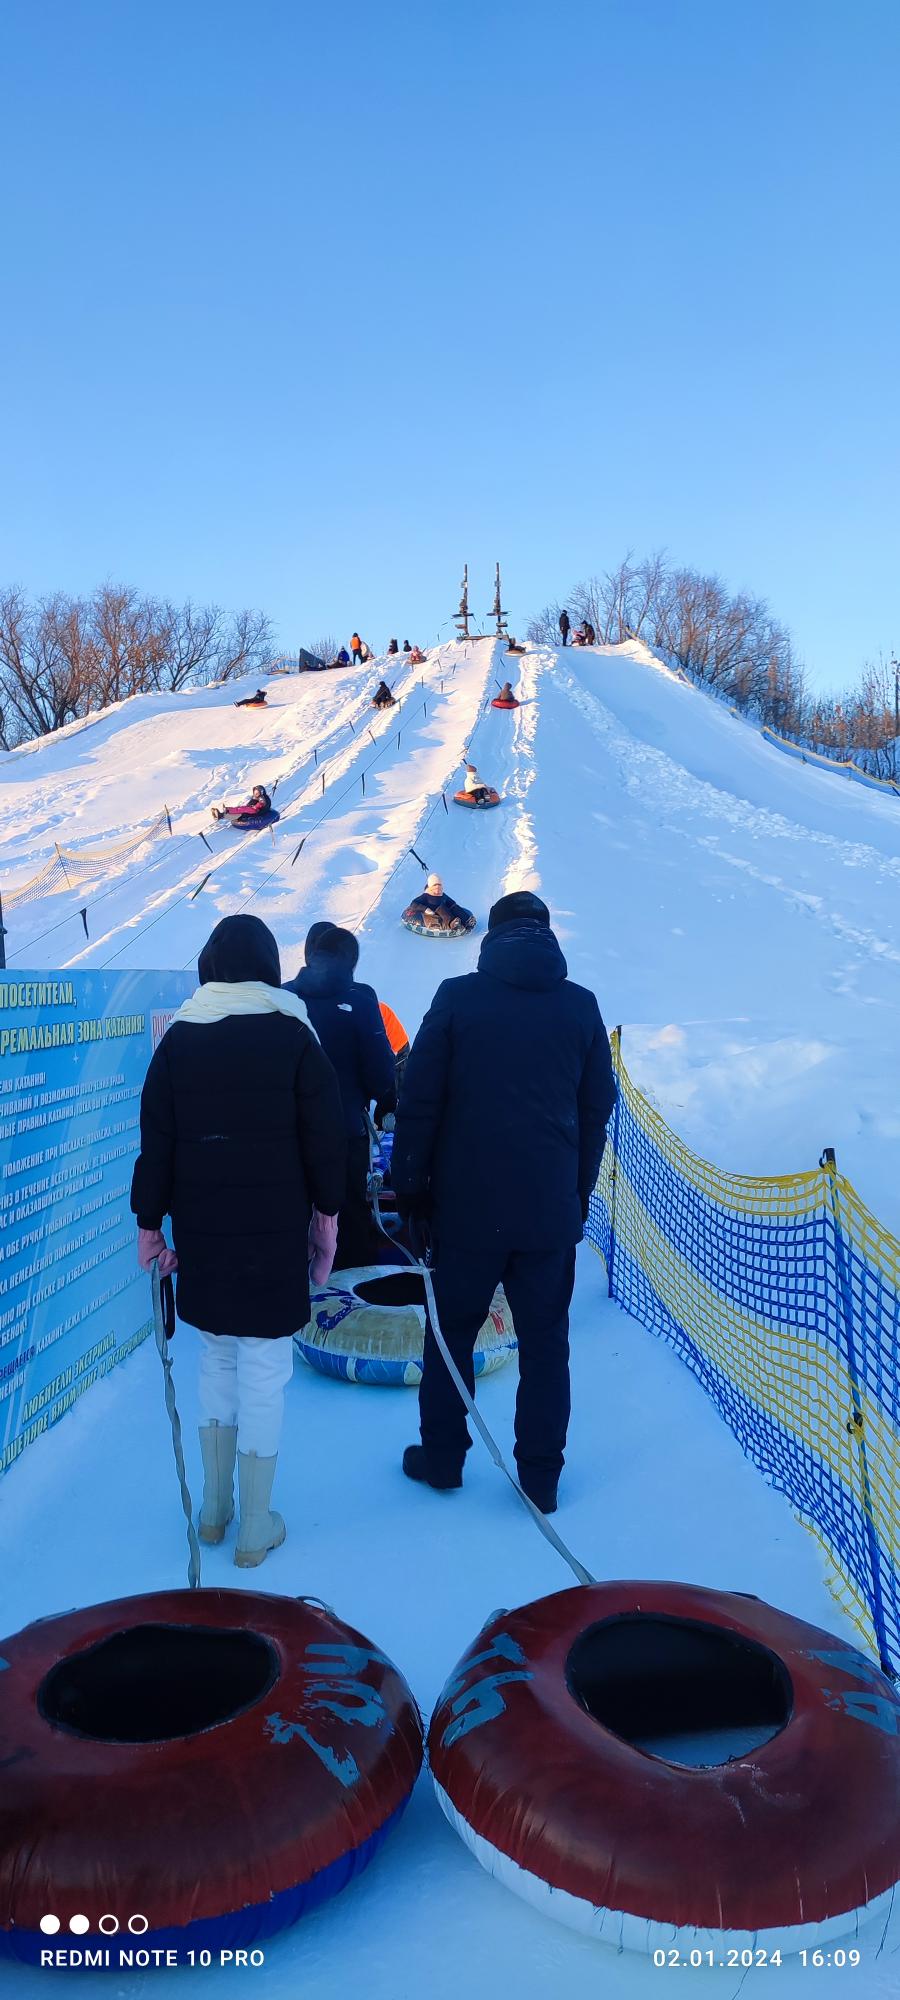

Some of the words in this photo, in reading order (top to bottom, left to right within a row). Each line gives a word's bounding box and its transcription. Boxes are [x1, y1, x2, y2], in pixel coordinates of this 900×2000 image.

[77, 1018, 103, 1043] ЗОНА
[105, 1014, 145, 1038] КАТАНИЯ!
[15, 1072, 46, 1091] КАТАНИЯ!
[40, 1085, 80, 1106] ВОЗМОЖНОГО
[17, 1114, 47, 1134] ПРАВИЛА
[3, 1151, 44, 1179] ПОЛОЖЕНИЕ
[45, 1146, 58, 1162] ПРИ
[21, 1177, 50, 1200] ТЕЧЕНИЕ
[6, 1241, 20, 1259] ОБЕ
[21, 1229, 44, 1250] РУЧКИ
[9, 1257, 53, 1289] НЕМЕДЛЕННО
[16, 1295, 31, 1319] ПРИ
[32, 1280, 56, 1306] СПУСКЕ
[22, 1366, 73, 1424] ЛЮБИТЕЛИ
